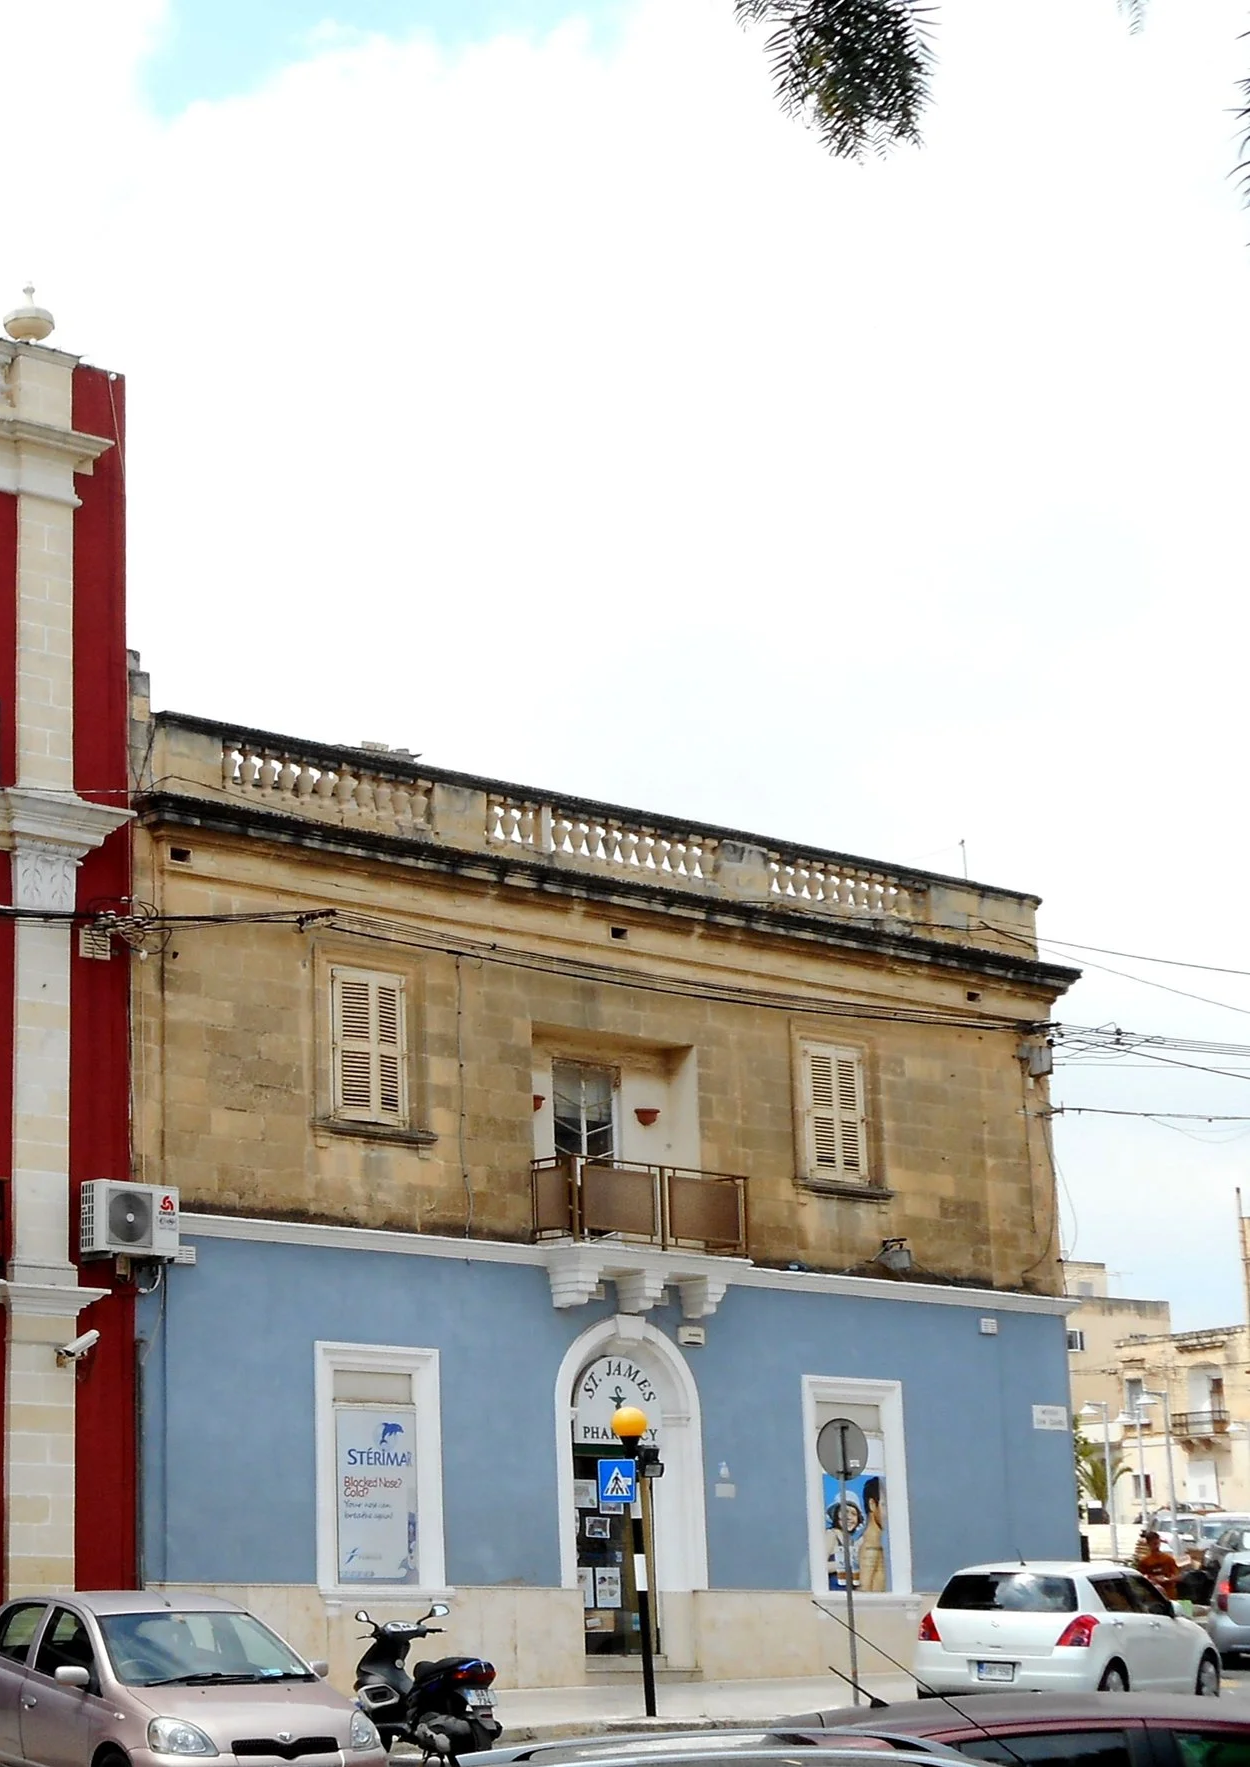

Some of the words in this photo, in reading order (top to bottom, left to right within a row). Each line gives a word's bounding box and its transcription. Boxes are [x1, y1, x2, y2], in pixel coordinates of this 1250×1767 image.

[605, 1360, 657, 1403] JAMES
[582, 1426, 658, 1442] PHARCY
[343, 1475, 377, 1489] Blocked
[379, 1477, 403, 1489] Nose?
[343, 1487, 369, 1498] Cold?
